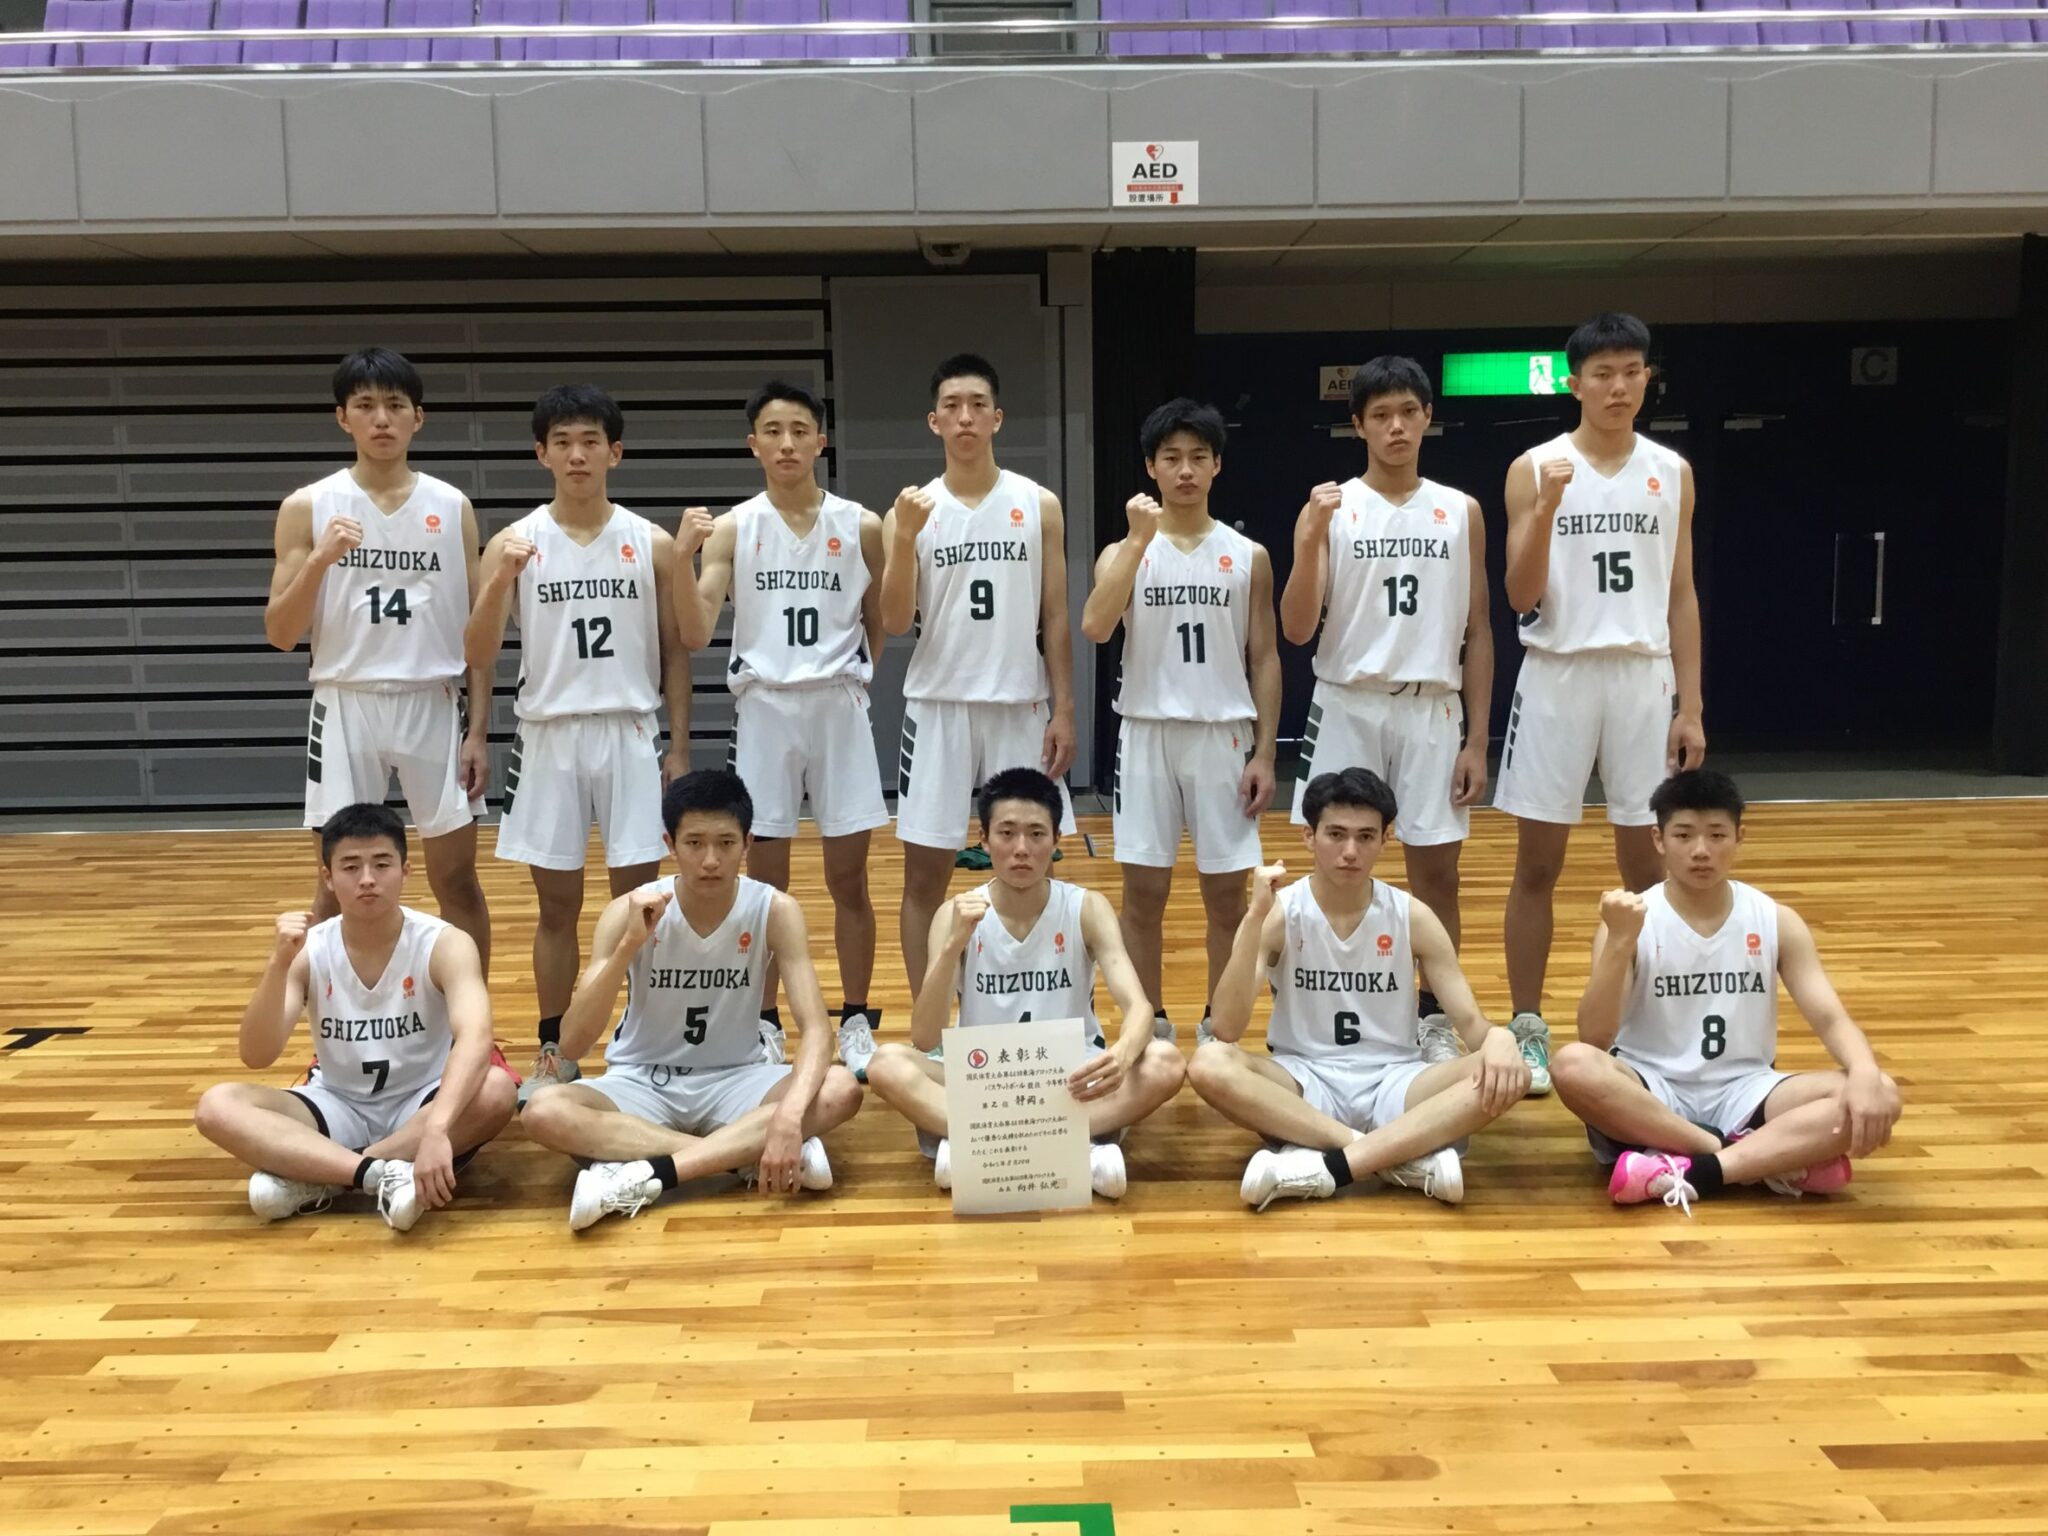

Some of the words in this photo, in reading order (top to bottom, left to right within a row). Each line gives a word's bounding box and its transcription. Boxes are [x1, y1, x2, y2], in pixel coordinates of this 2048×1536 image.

[1132, 163, 1178, 179] AED
[1860, 349, 1889, 382] C
[1557, 513, 1660, 536] SHIZUOKA
[934, 541, 1028, 568] SHIZUOKA
[1353, 538, 1450, 560] SHIZUOKA
[755, 570, 842, 591] SHIZUOKA
[1592, 550, 1633, 593] 15
[366, 586, 412, 625] 14
[537, 578, 638, 603] SHIZUOKA
[969, 579, 994, 620] 9
[1383, 574, 1418, 617] 13
[571, 616, 614, 659] 12
[783, 606, 819, 646] 10
[1177, 622, 1206, 663] 11
[649, 968, 750, 989] SHIZUOKA
[976, 968, 1072, 994] SHIZUOKA
[1295, 968, 1399, 993] SHIZUOKA
[1654, 971, 1766, 997] SHIZUOKA
[320, 1011, 426, 1042] SHIZUOKA
[684, 1005, 709, 1045] 5
[1334, 1010, 1360, 1046] 6
[1701, 1014, 1726, 1060] 8
[997, 1047, 1048, 1063] 表彰状
[362, 1059, 390, 1095] 7
